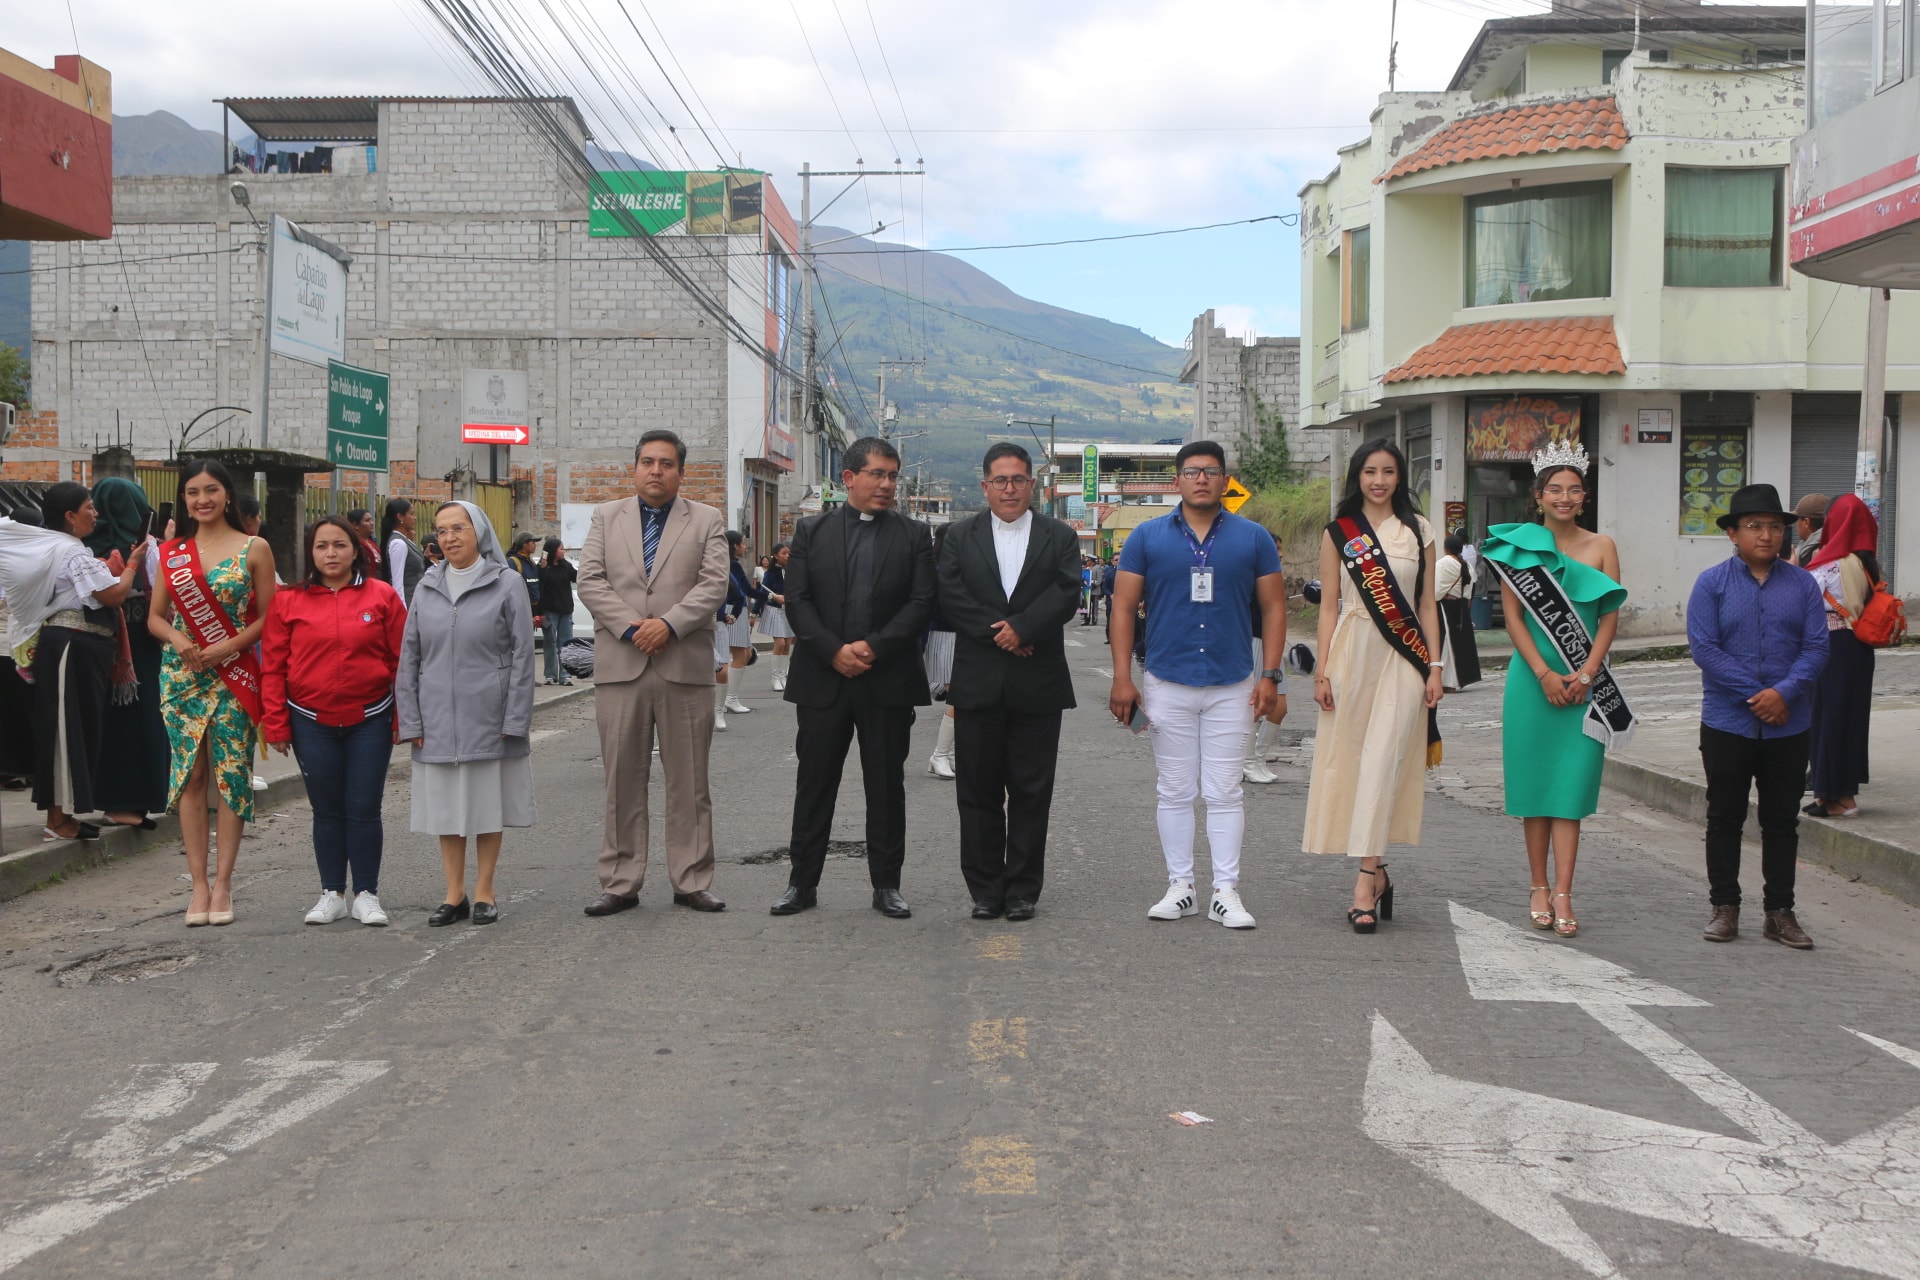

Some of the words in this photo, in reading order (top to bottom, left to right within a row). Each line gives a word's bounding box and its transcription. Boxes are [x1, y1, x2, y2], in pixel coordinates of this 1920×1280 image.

[592, 193, 684, 211] SELVALEGRE
[296, 252, 328, 290] Cabañas
[305, 282, 325, 321] Lago
[331, 374, 339, 393] San
[352, 379, 359, 399] de
[360, 382, 373, 405] Lago
[347, 442, 377, 462] Otavalo
[1481, 450, 1500, 459] 100%
[1502, 450, 1528, 459] POLLOS
[1084, 459, 1095, 497] Trebol
[170, 567, 206, 609] CORTE
[1361, 566, 1397, 614] Reina
[1387, 615, 1412, 635] de
[189, 603, 212, 627] DE
[1565, 611, 1588, 644] BARRIO
[200, 619, 241, 668] HONR
[1537, 599, 1562, 626] LA
[1555, 622, 1588, 670] COSTA
[227, 671, 239, 681] 20
[1593, 682, 1616, 702] 2025
